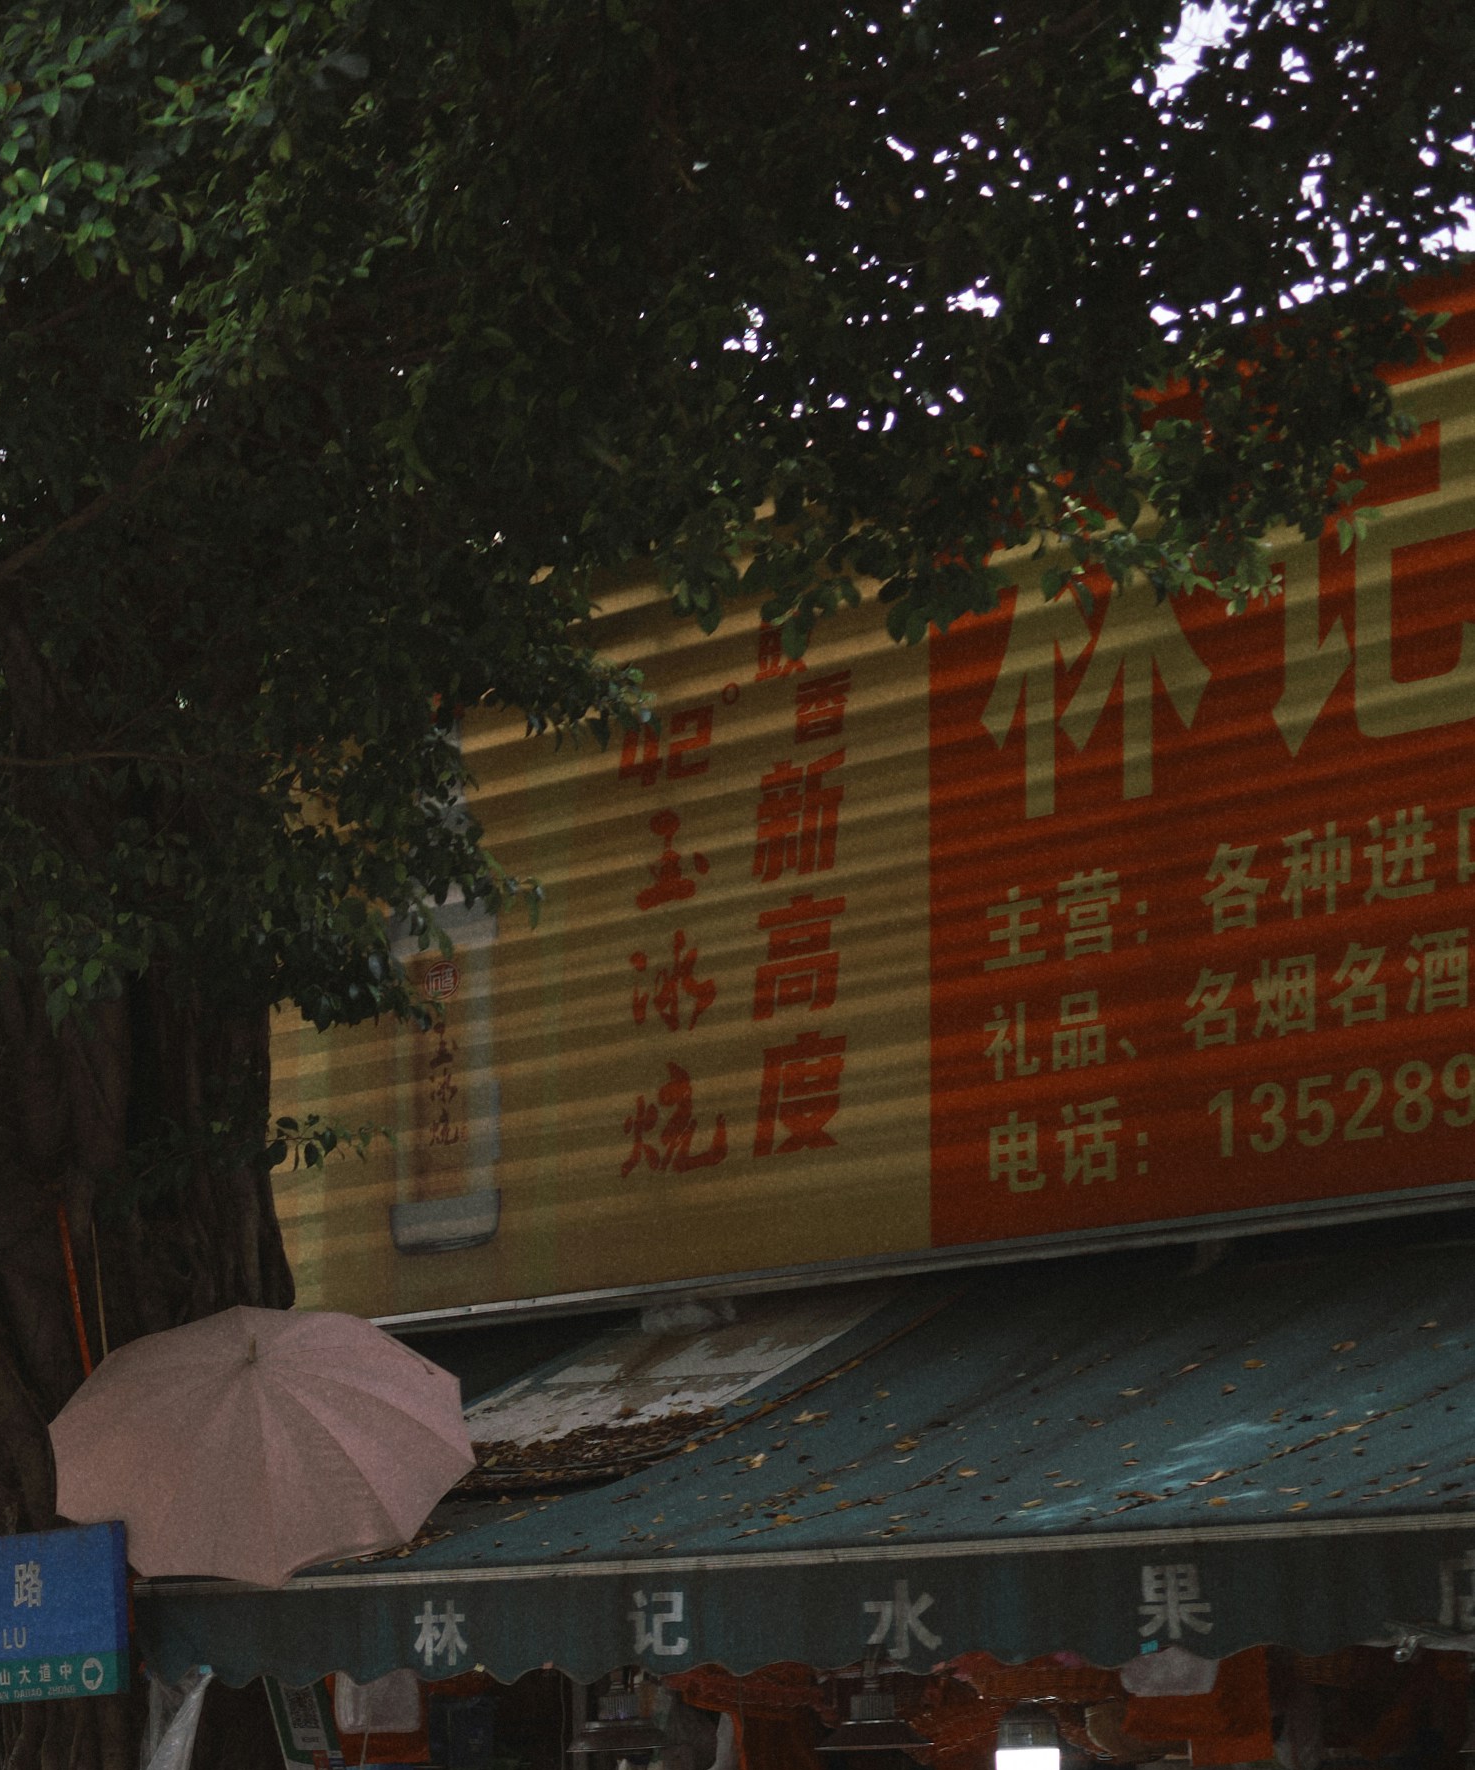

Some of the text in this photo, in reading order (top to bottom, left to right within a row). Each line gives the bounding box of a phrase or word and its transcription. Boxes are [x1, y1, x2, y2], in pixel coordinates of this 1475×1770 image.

[1201, 804, 1475, 937] 各种进
[620, 808, 729, 1180] 玉冰烧
[2, 1626, 28, 1650] LU
